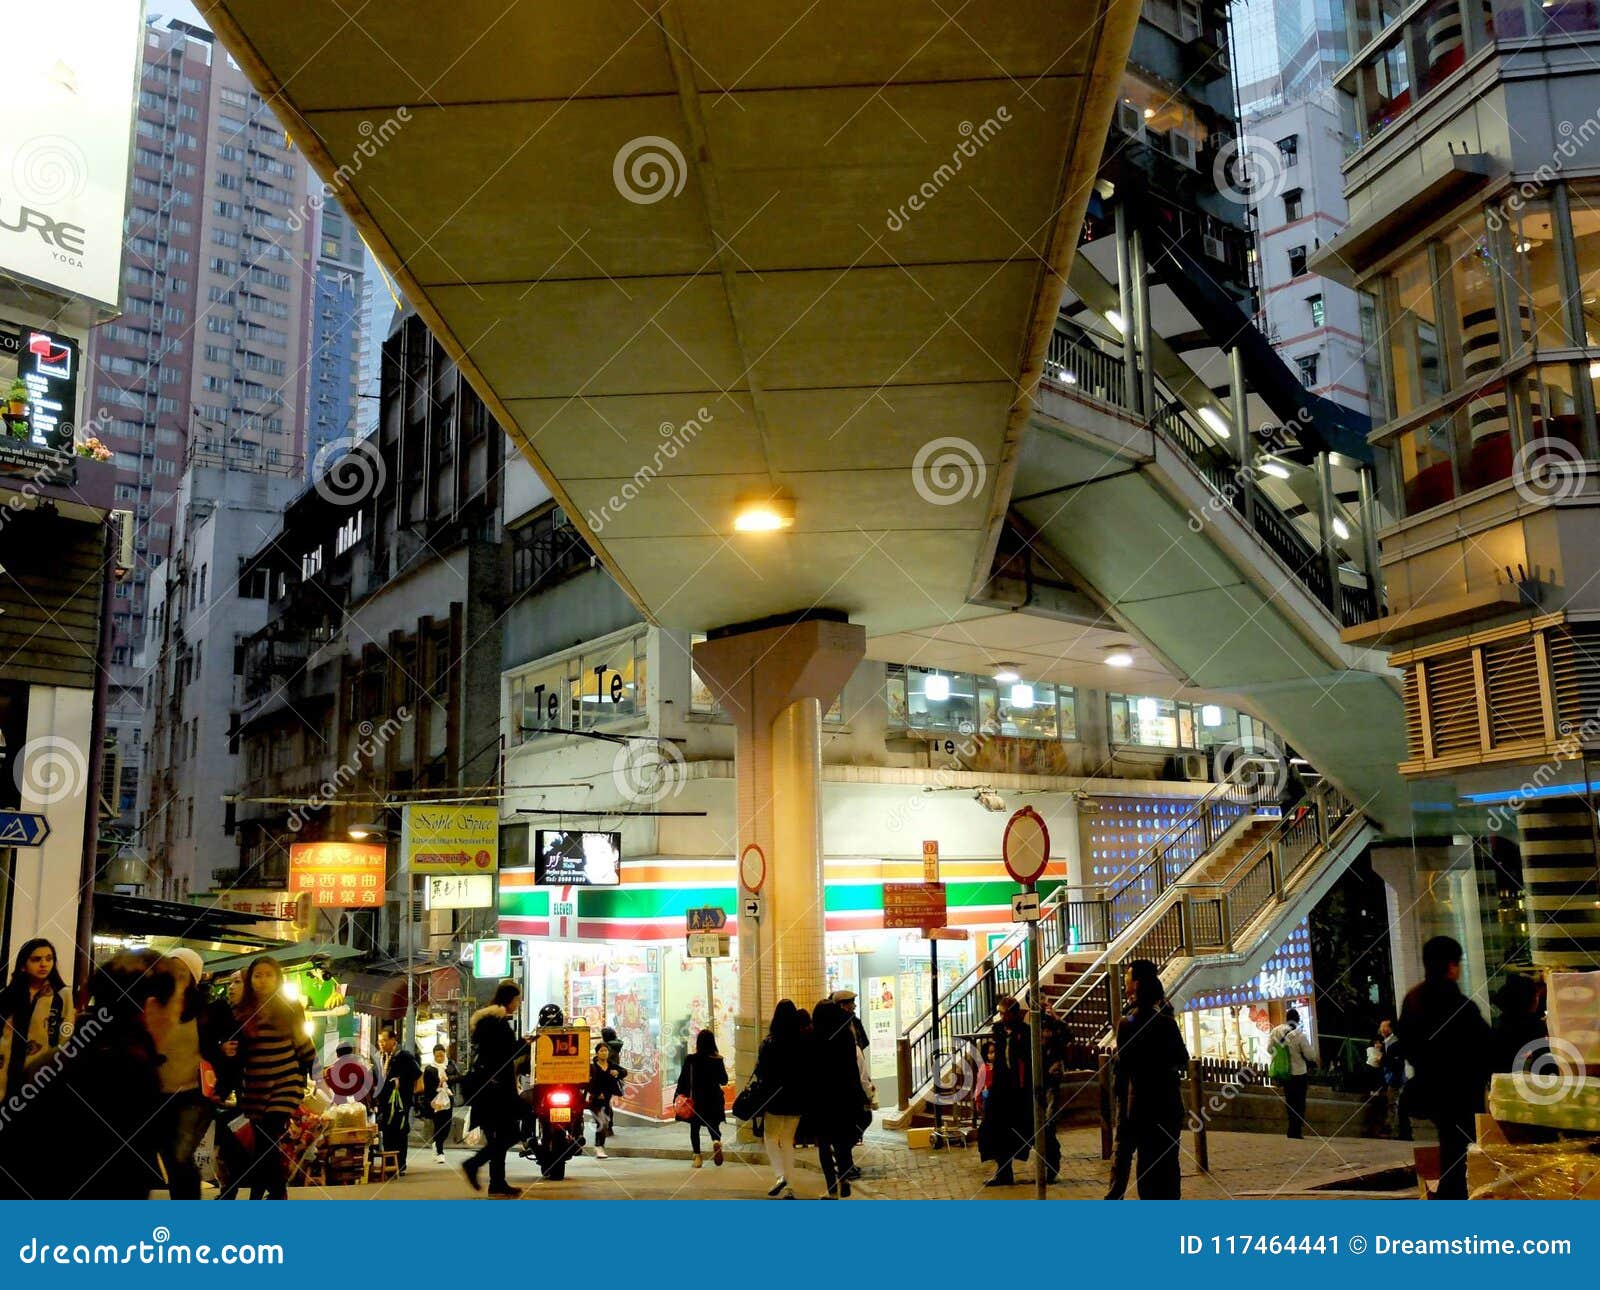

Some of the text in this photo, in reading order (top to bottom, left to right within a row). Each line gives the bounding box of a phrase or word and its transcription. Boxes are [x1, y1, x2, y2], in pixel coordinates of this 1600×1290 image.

[53, 252, 83, 268] YOGA
[534, 664, 623, 721] Te Te
[415, 813, 493, 836] Noble Spice
